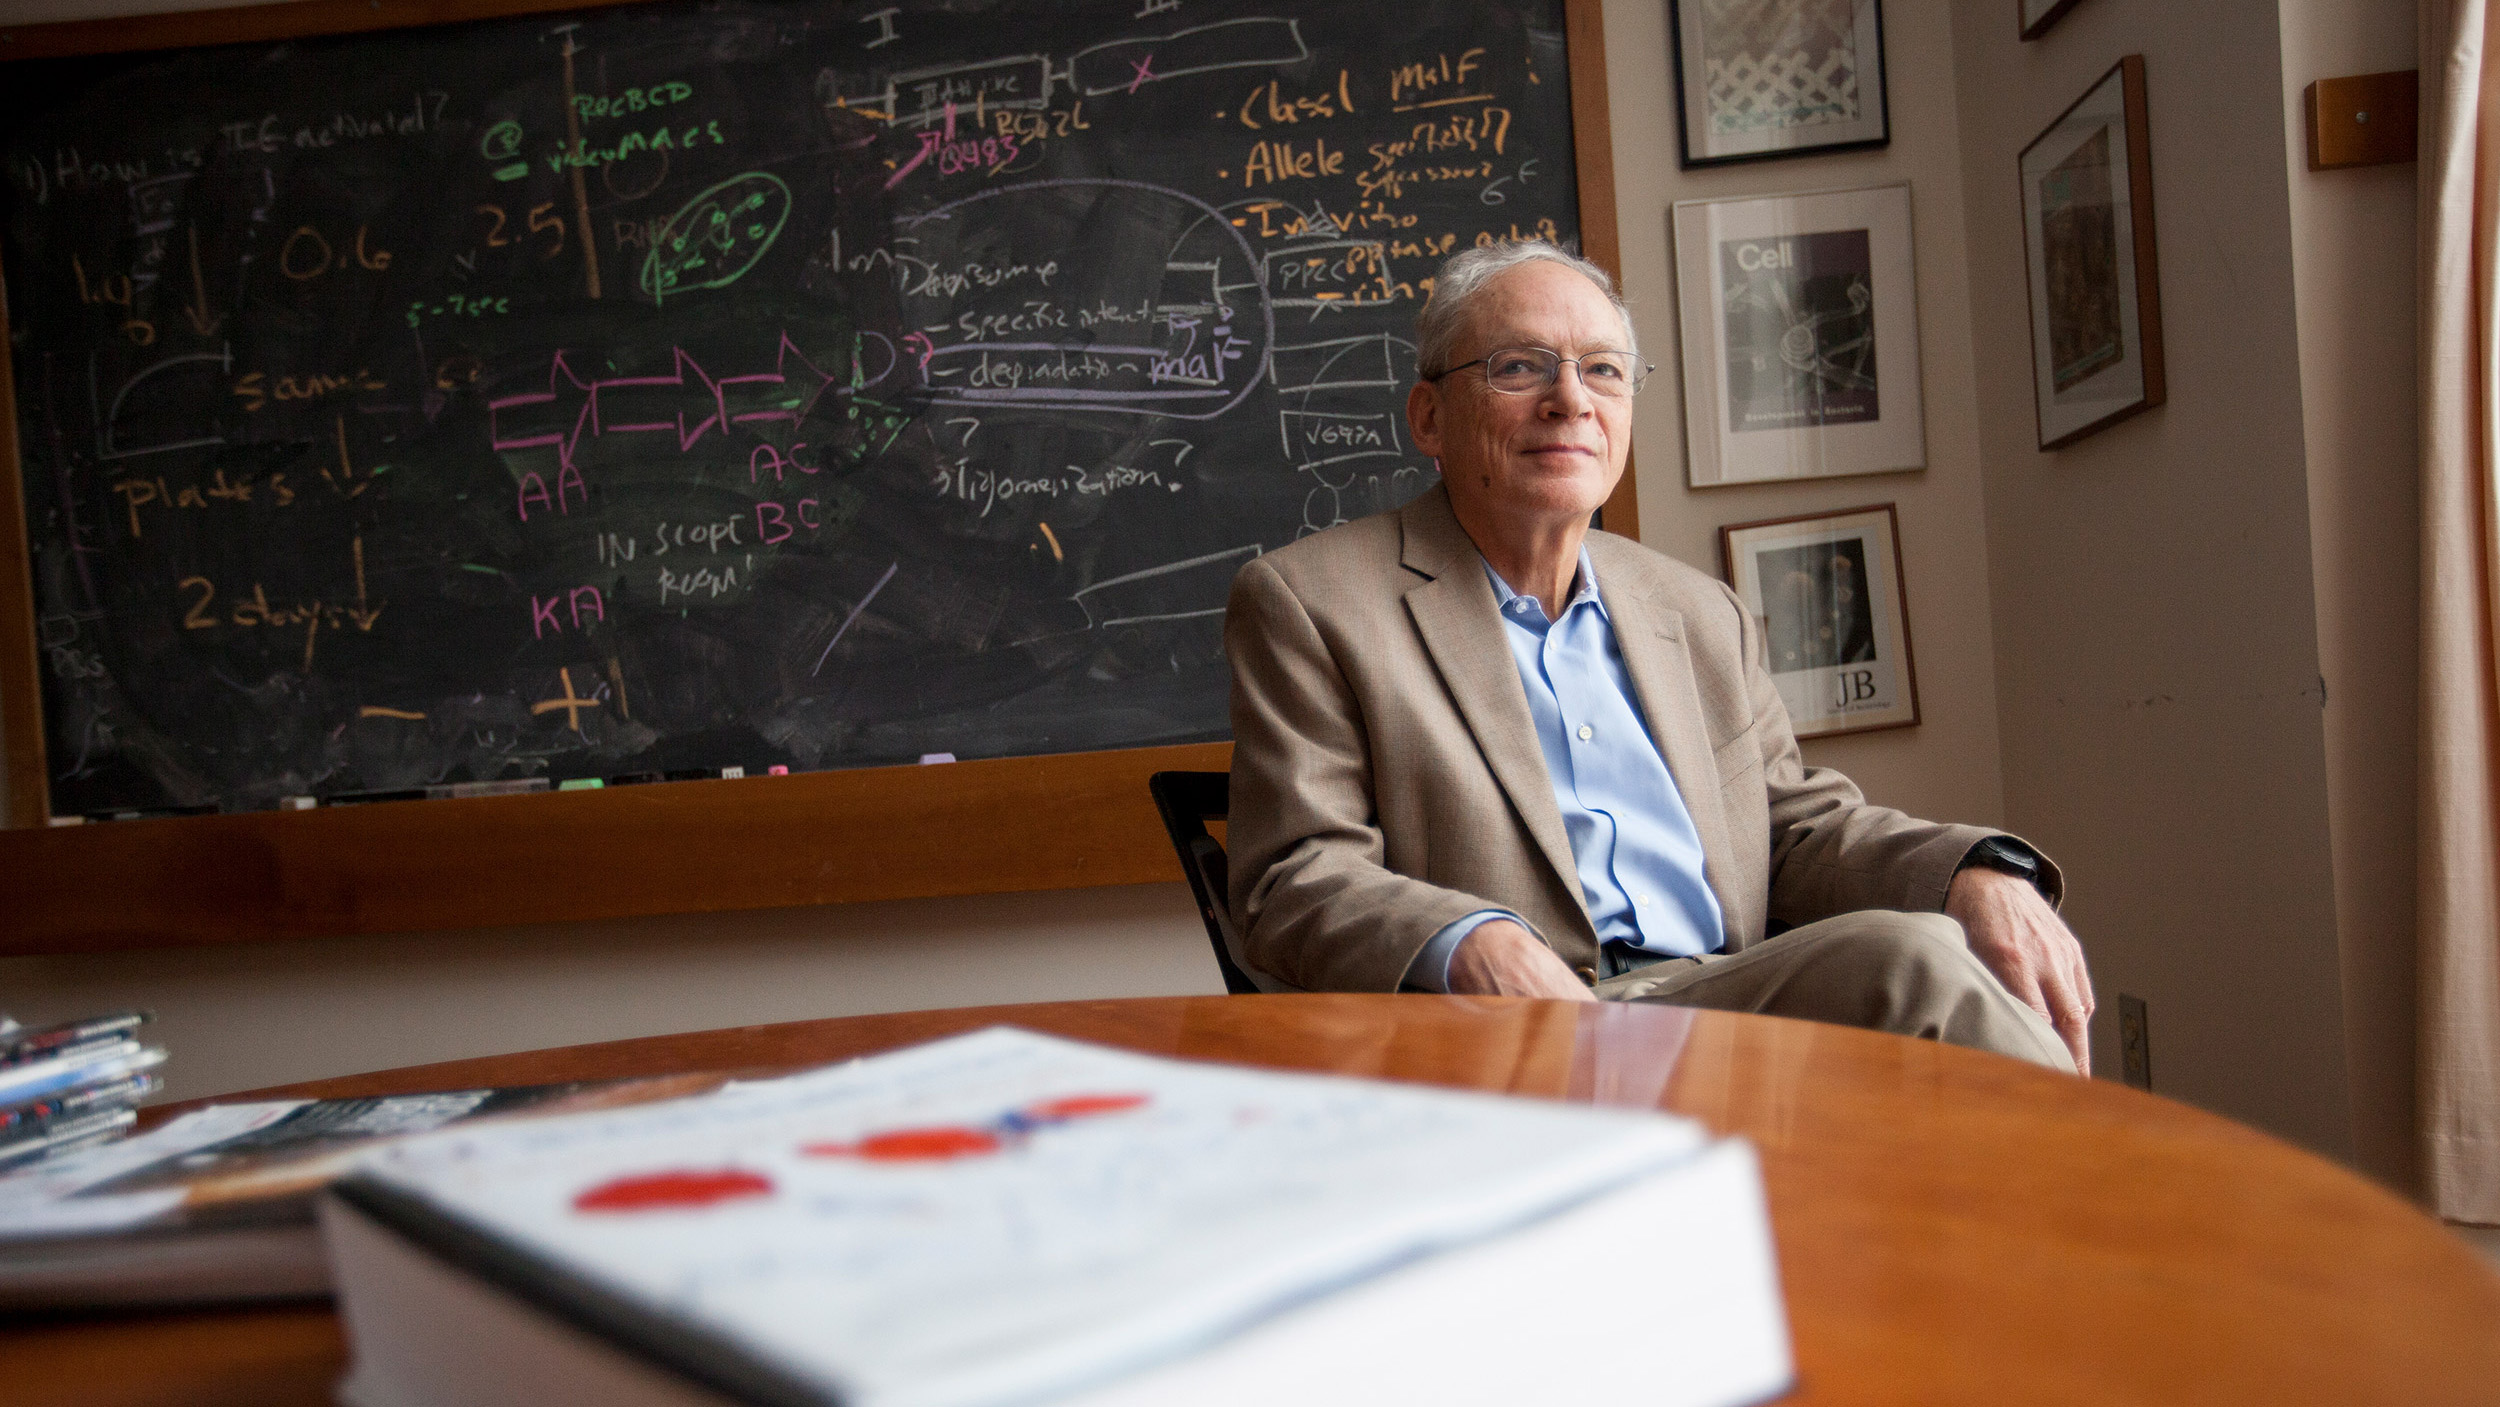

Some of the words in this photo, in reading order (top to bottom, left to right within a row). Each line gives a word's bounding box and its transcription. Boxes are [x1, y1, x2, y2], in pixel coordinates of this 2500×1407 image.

[1246, 138, 1345, 188] Allele
[280, 224, 393, 280] 0.6
[476, 202, 566, 260] 2.5
[1736, 241, 1793, 271] Cell
[750, 443, 820, 484] AC
[518, 460, 588, 522] AA
[755, 499, 820, 545] BC
[532, 586, 604, 639] KA
[1836, 669, 1876, 708] JB
